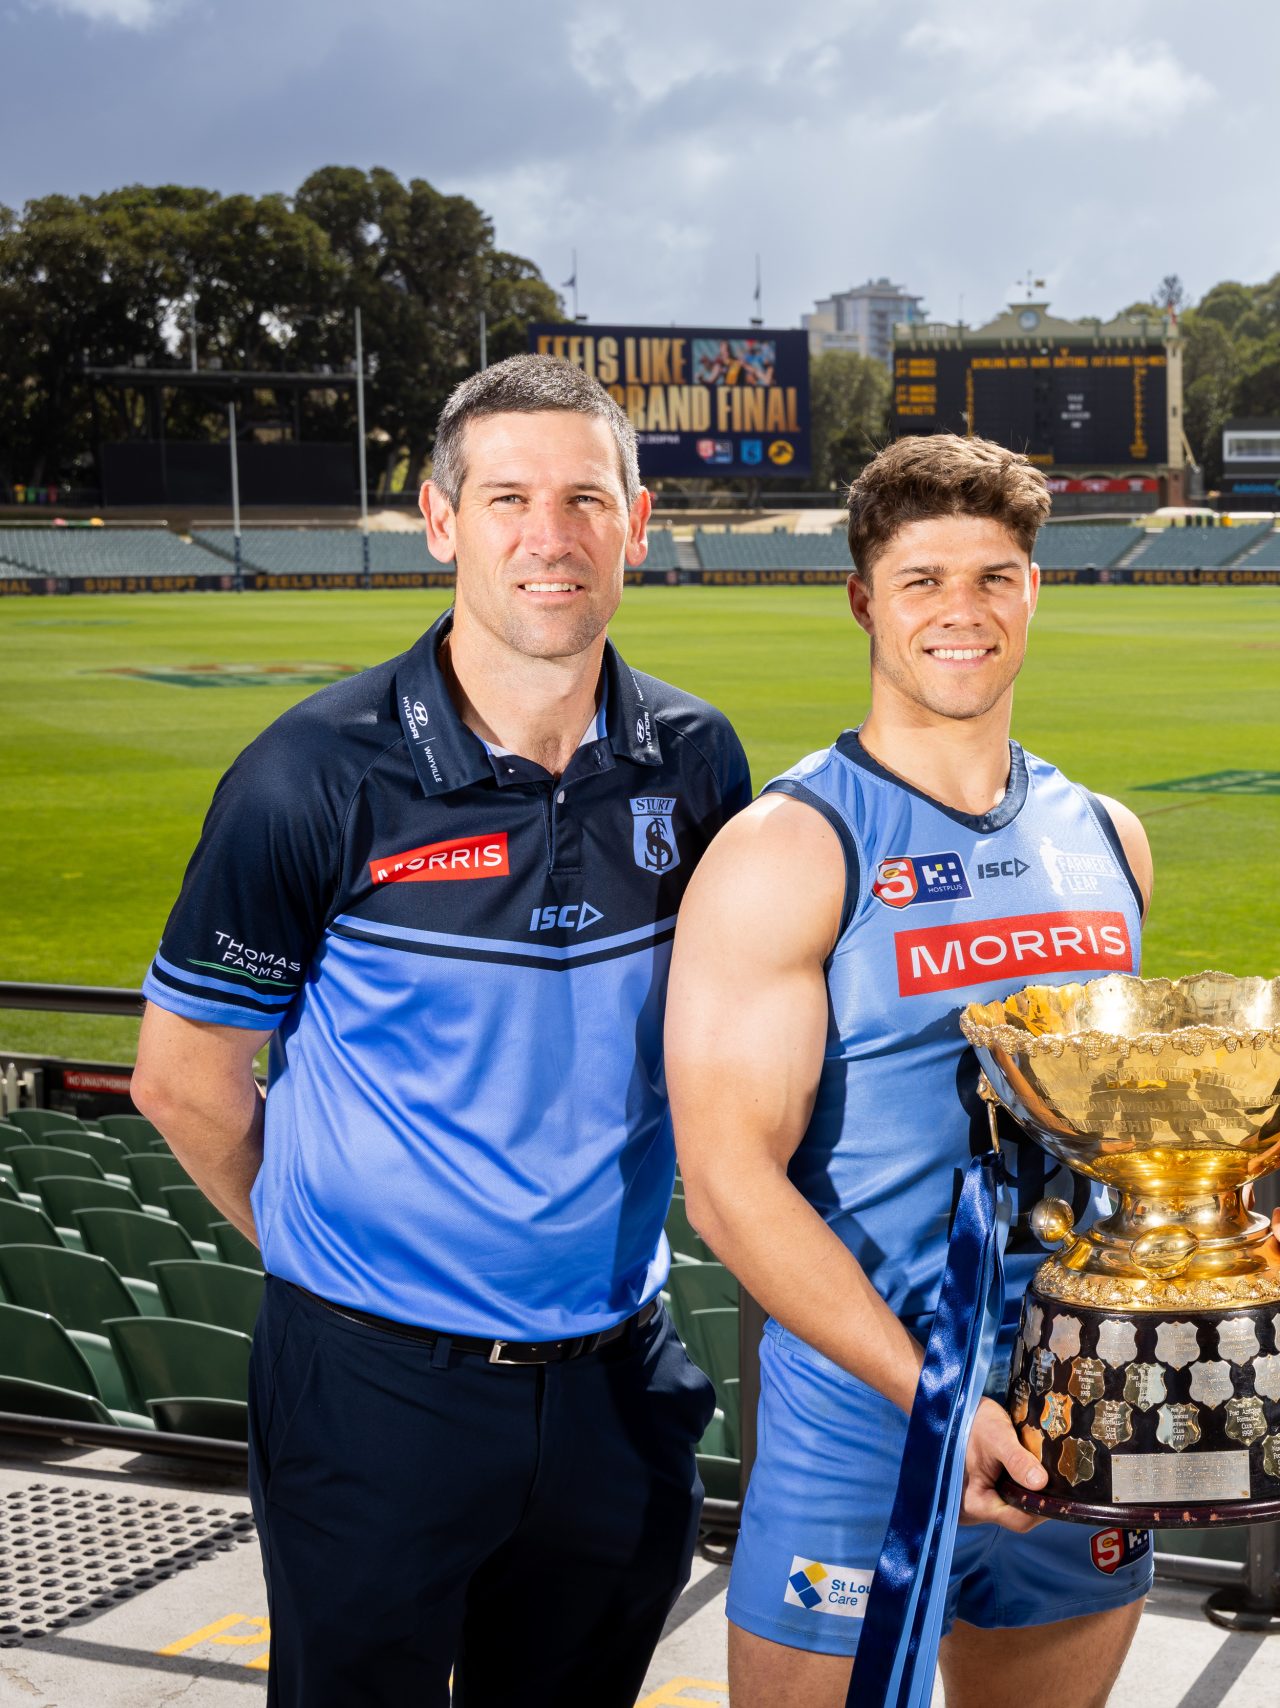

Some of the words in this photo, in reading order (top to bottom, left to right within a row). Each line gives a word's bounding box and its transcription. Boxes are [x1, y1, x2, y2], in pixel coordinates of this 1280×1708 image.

[625, 336, 687, 385] LIKE
[717, 386, 800, 432] FINAL
[0, 581, 31, 594] NAL
[402, 696, 420, 740] HYUNDAI
[423, 745, 443, 783] WAYVILLE
[636, 798, 673, 812] STURT
[977, 859, 1014, 880] ISC
[927, 883, 963, 894] HOSTPLUS
[529, 904, 579, 932] ISC
[215, 930, 301, 972] THOMAS
[910, 925, 1127, 979] MORRIS
[222, 951, 284, 980] FARMS
[828, 1591, 858, 1606] Care
[831, 1578, 846, 1592] St
[849, 1581, 870, 1594] Lou
